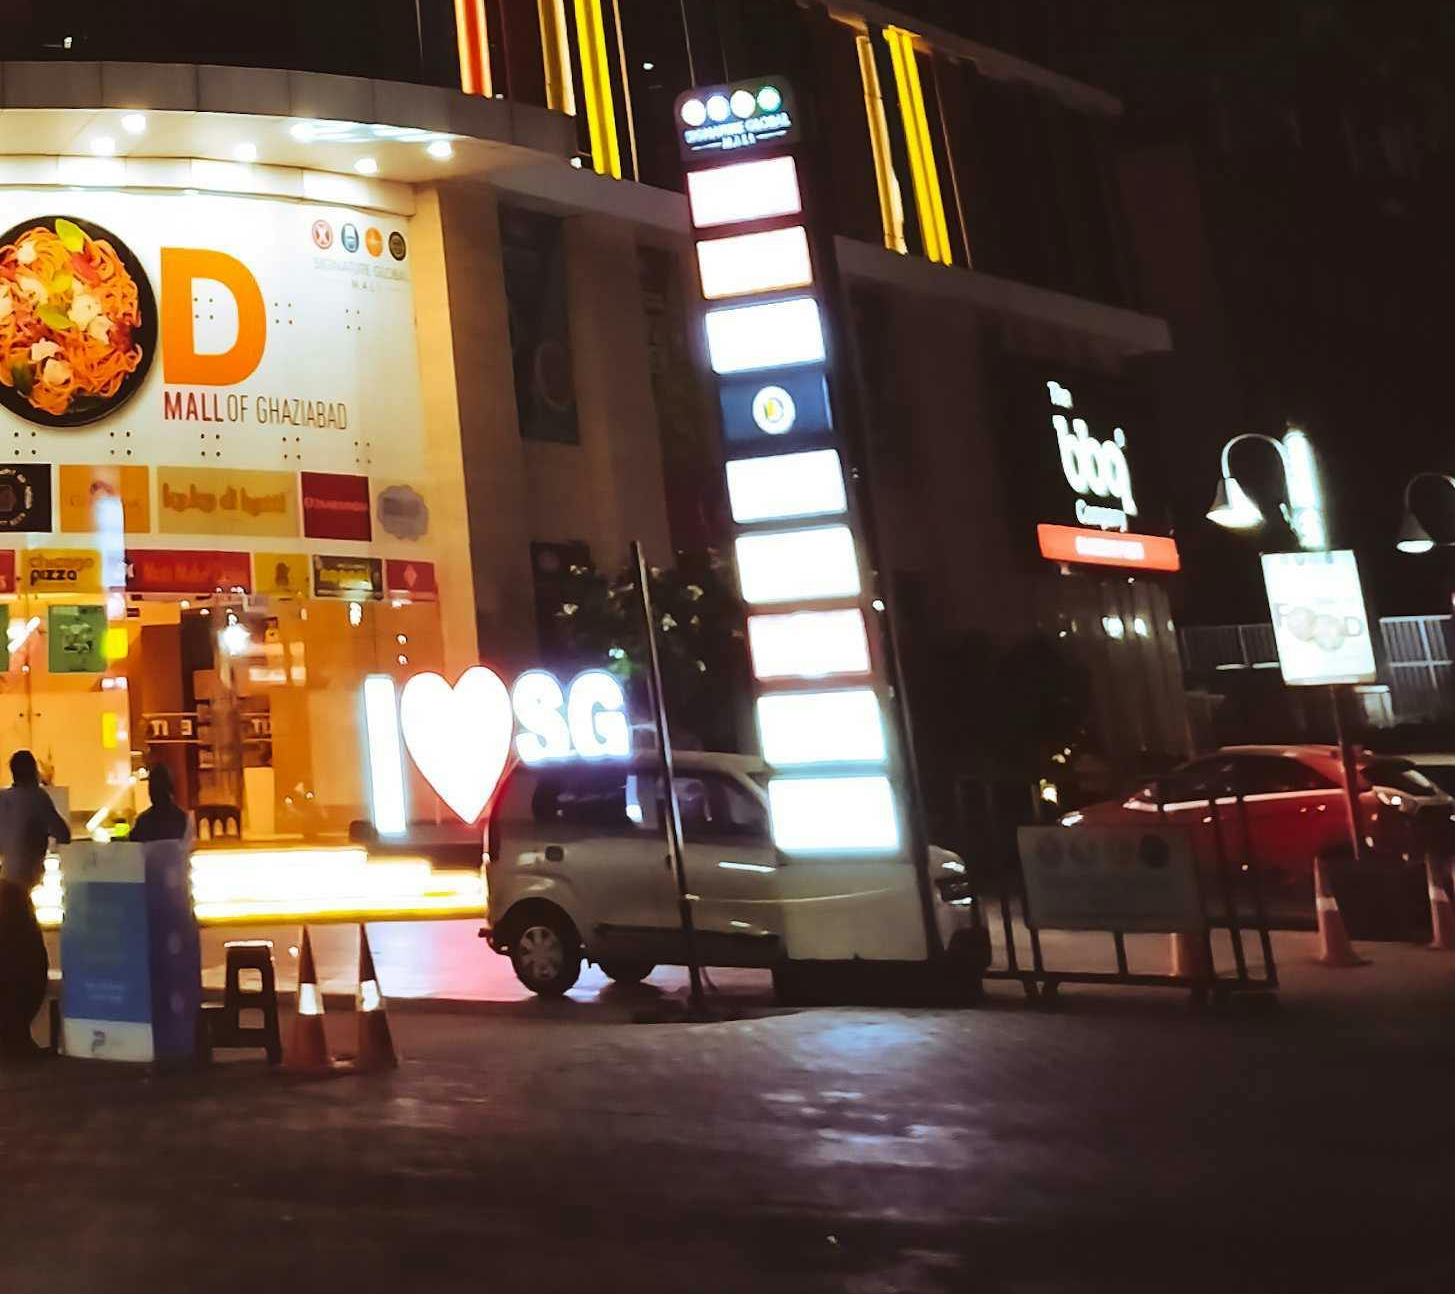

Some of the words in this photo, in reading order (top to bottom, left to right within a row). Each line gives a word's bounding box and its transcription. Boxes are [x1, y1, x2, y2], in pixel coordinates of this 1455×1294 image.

[164, 391, 224, 422] MALL
[227, 394, 248, 422] OF
[256, 396, 348, 430] GHAZIABAD
[30, 568, 78, 587] pizza
[510, 669, 631, 765] SG
